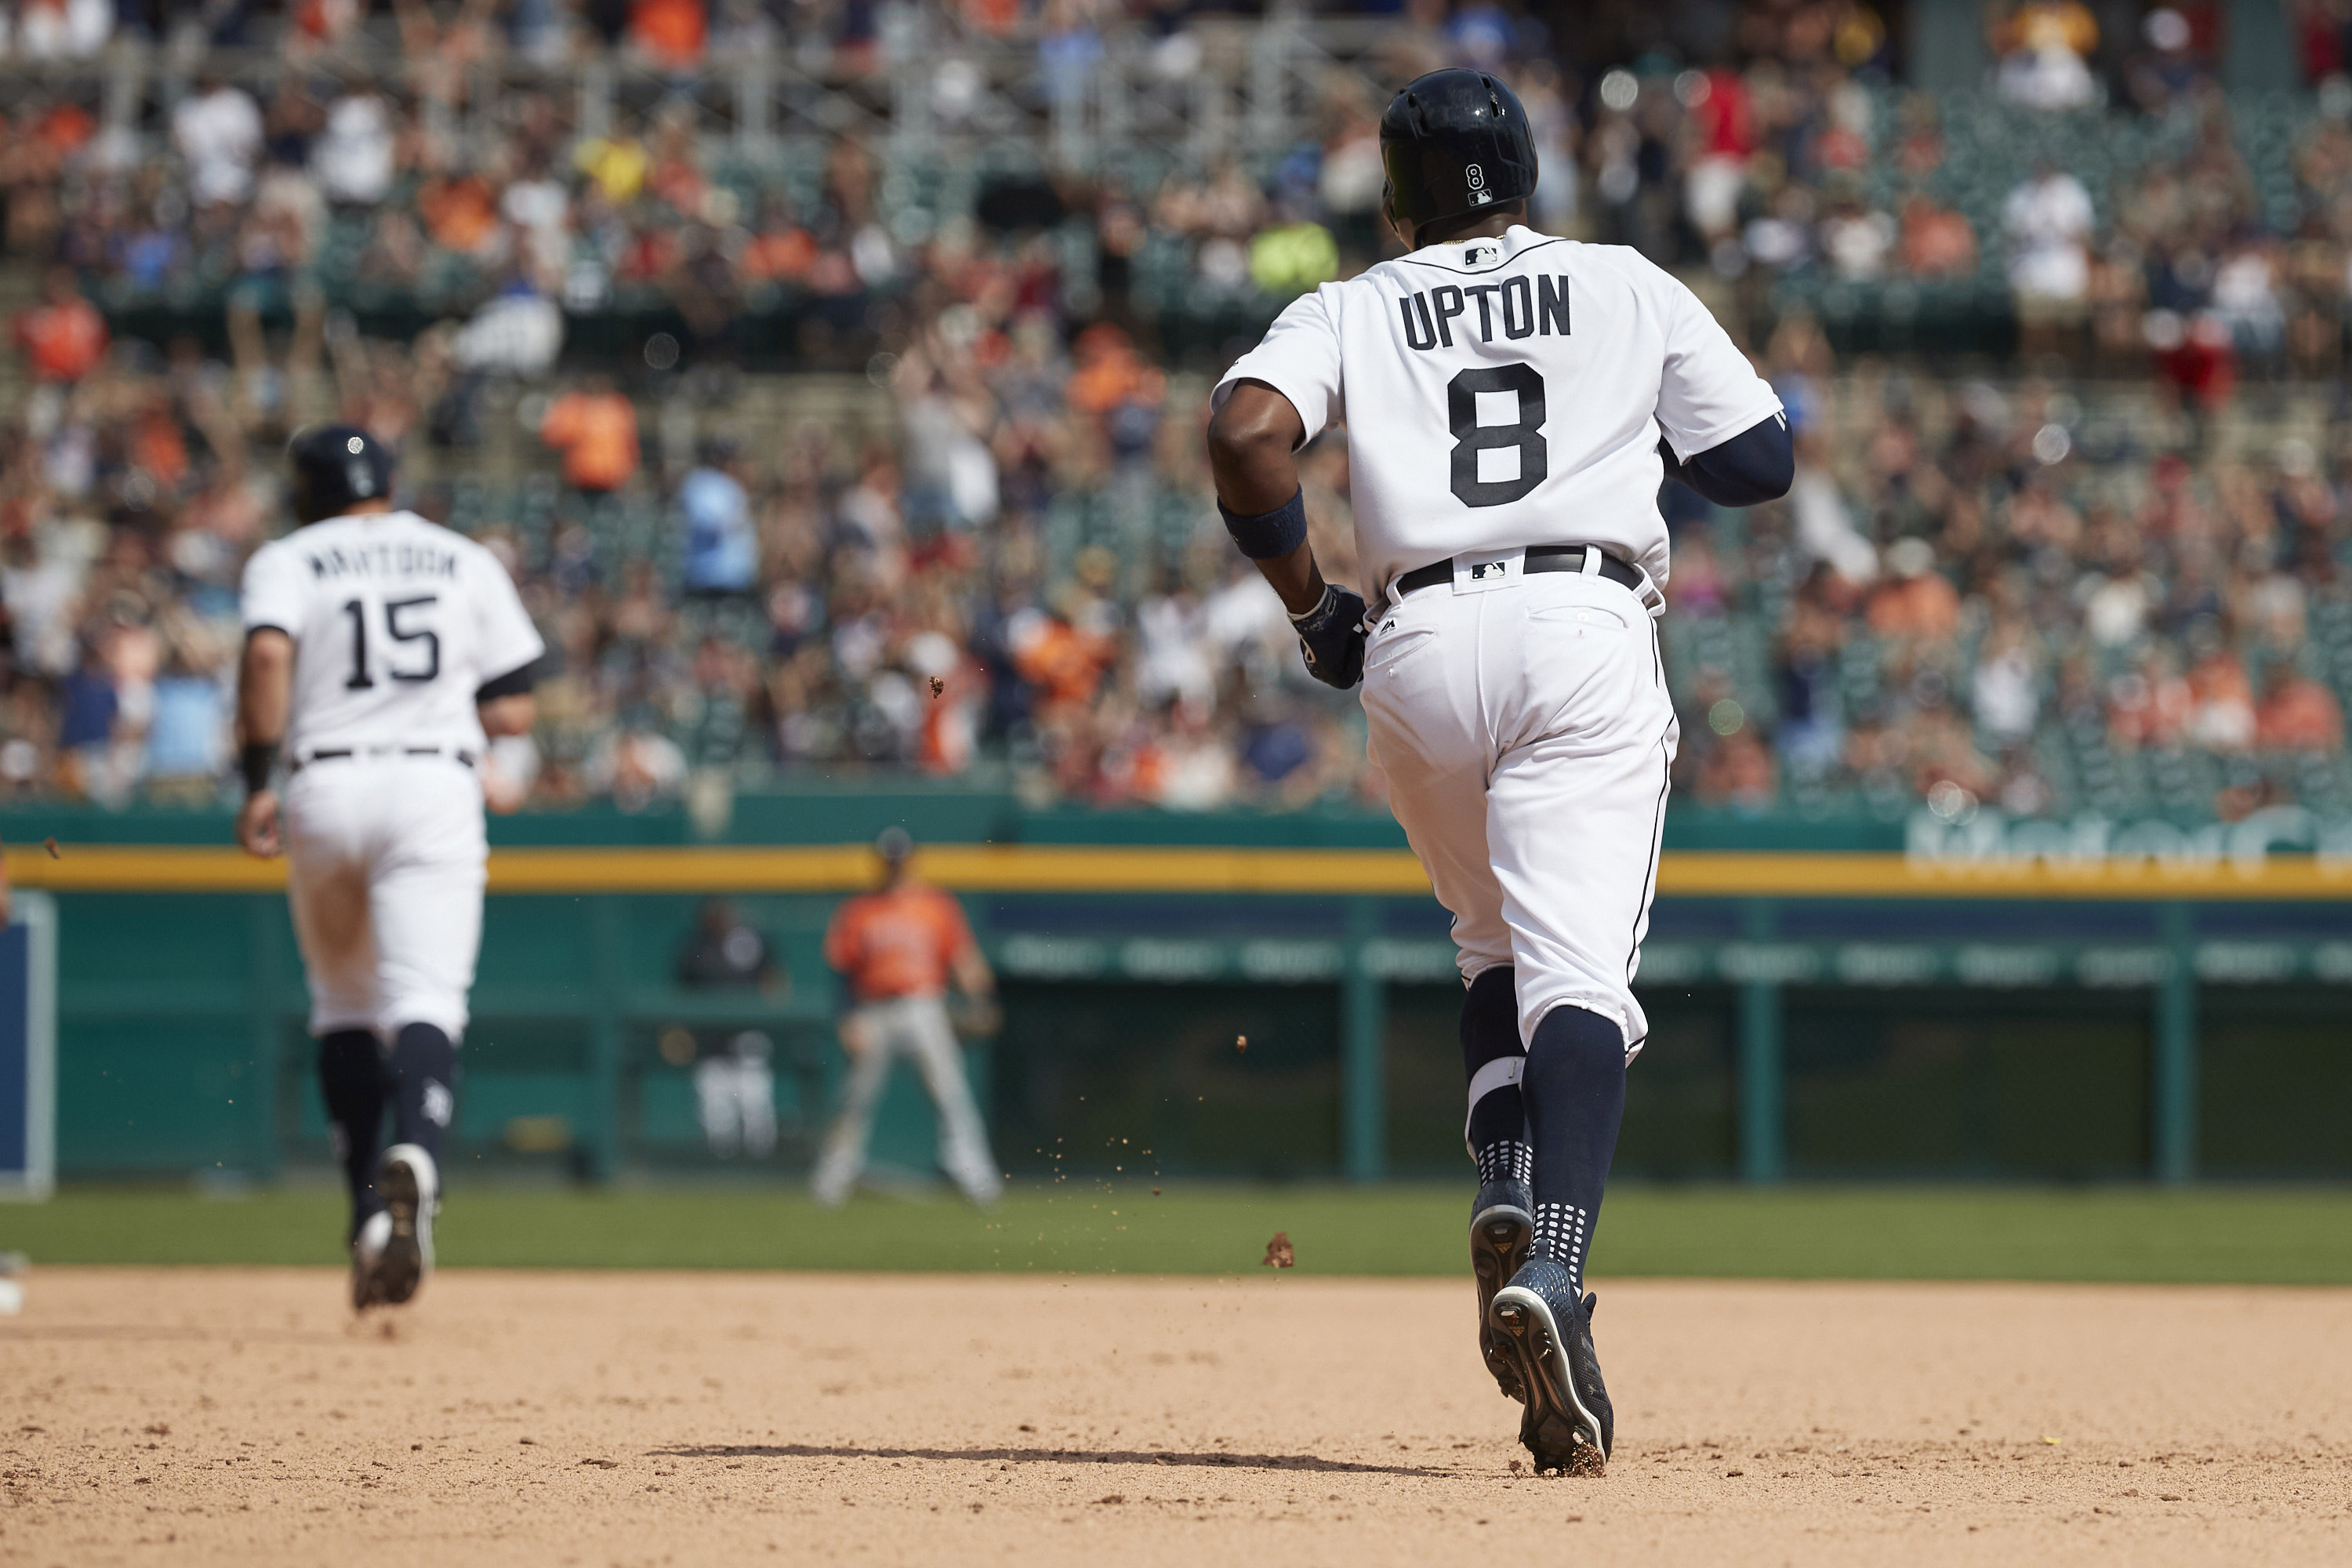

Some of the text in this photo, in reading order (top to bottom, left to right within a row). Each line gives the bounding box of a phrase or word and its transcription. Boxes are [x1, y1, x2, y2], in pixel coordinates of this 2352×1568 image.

[1465, 163, 1485, 191] 8
[1399, 274, 1571, 351] UPTON
[1447, 361, 1548, 509] 8
[343, 594, 440, 690] 15
